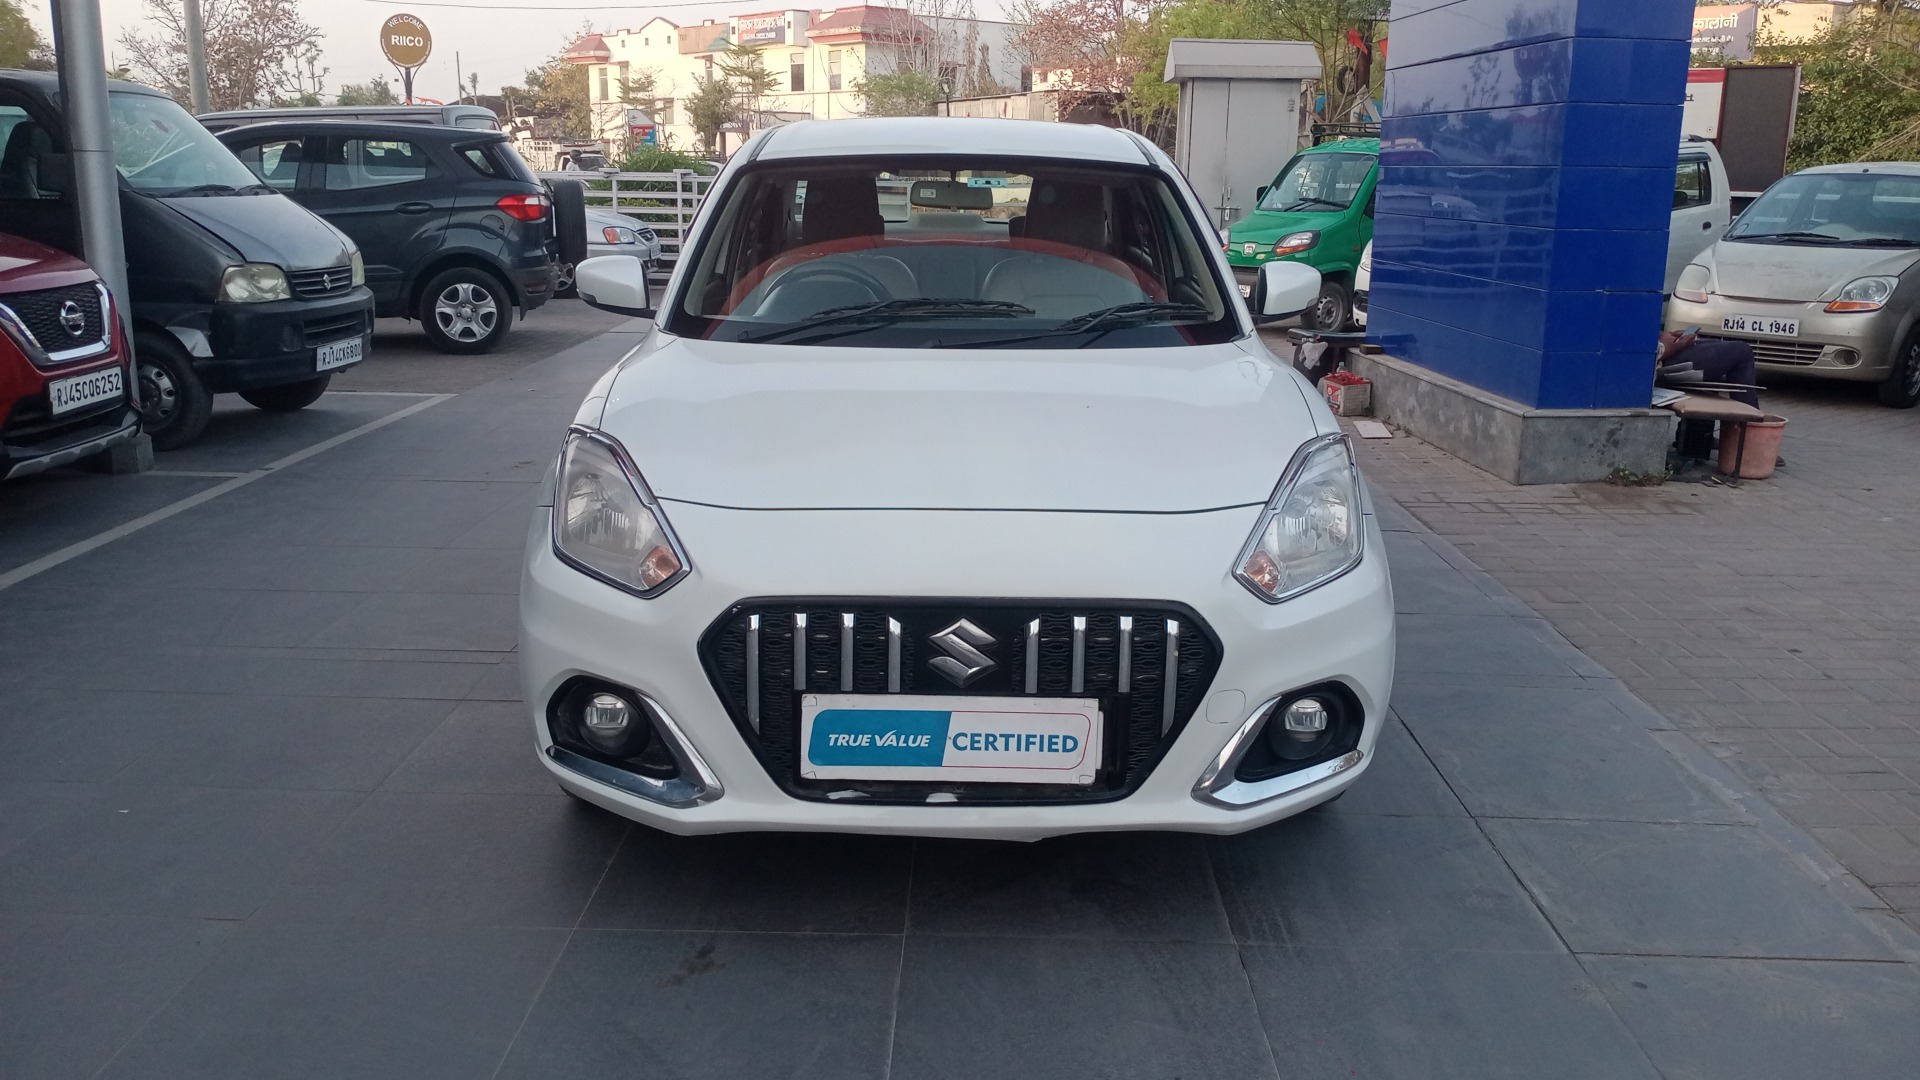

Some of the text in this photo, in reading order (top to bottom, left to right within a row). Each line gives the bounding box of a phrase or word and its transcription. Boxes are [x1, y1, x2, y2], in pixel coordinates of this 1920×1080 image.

[387, 15, 424, 31] WELCOME
[391, 34, 424, 47] RIICO
[1723, 318, 1795, 334] RJ14 CL 1946
[57, 372, 121, 407] RJ45CQ6252
[828, 729, 1079, 753] TRUE VALUE CERTIFIED
